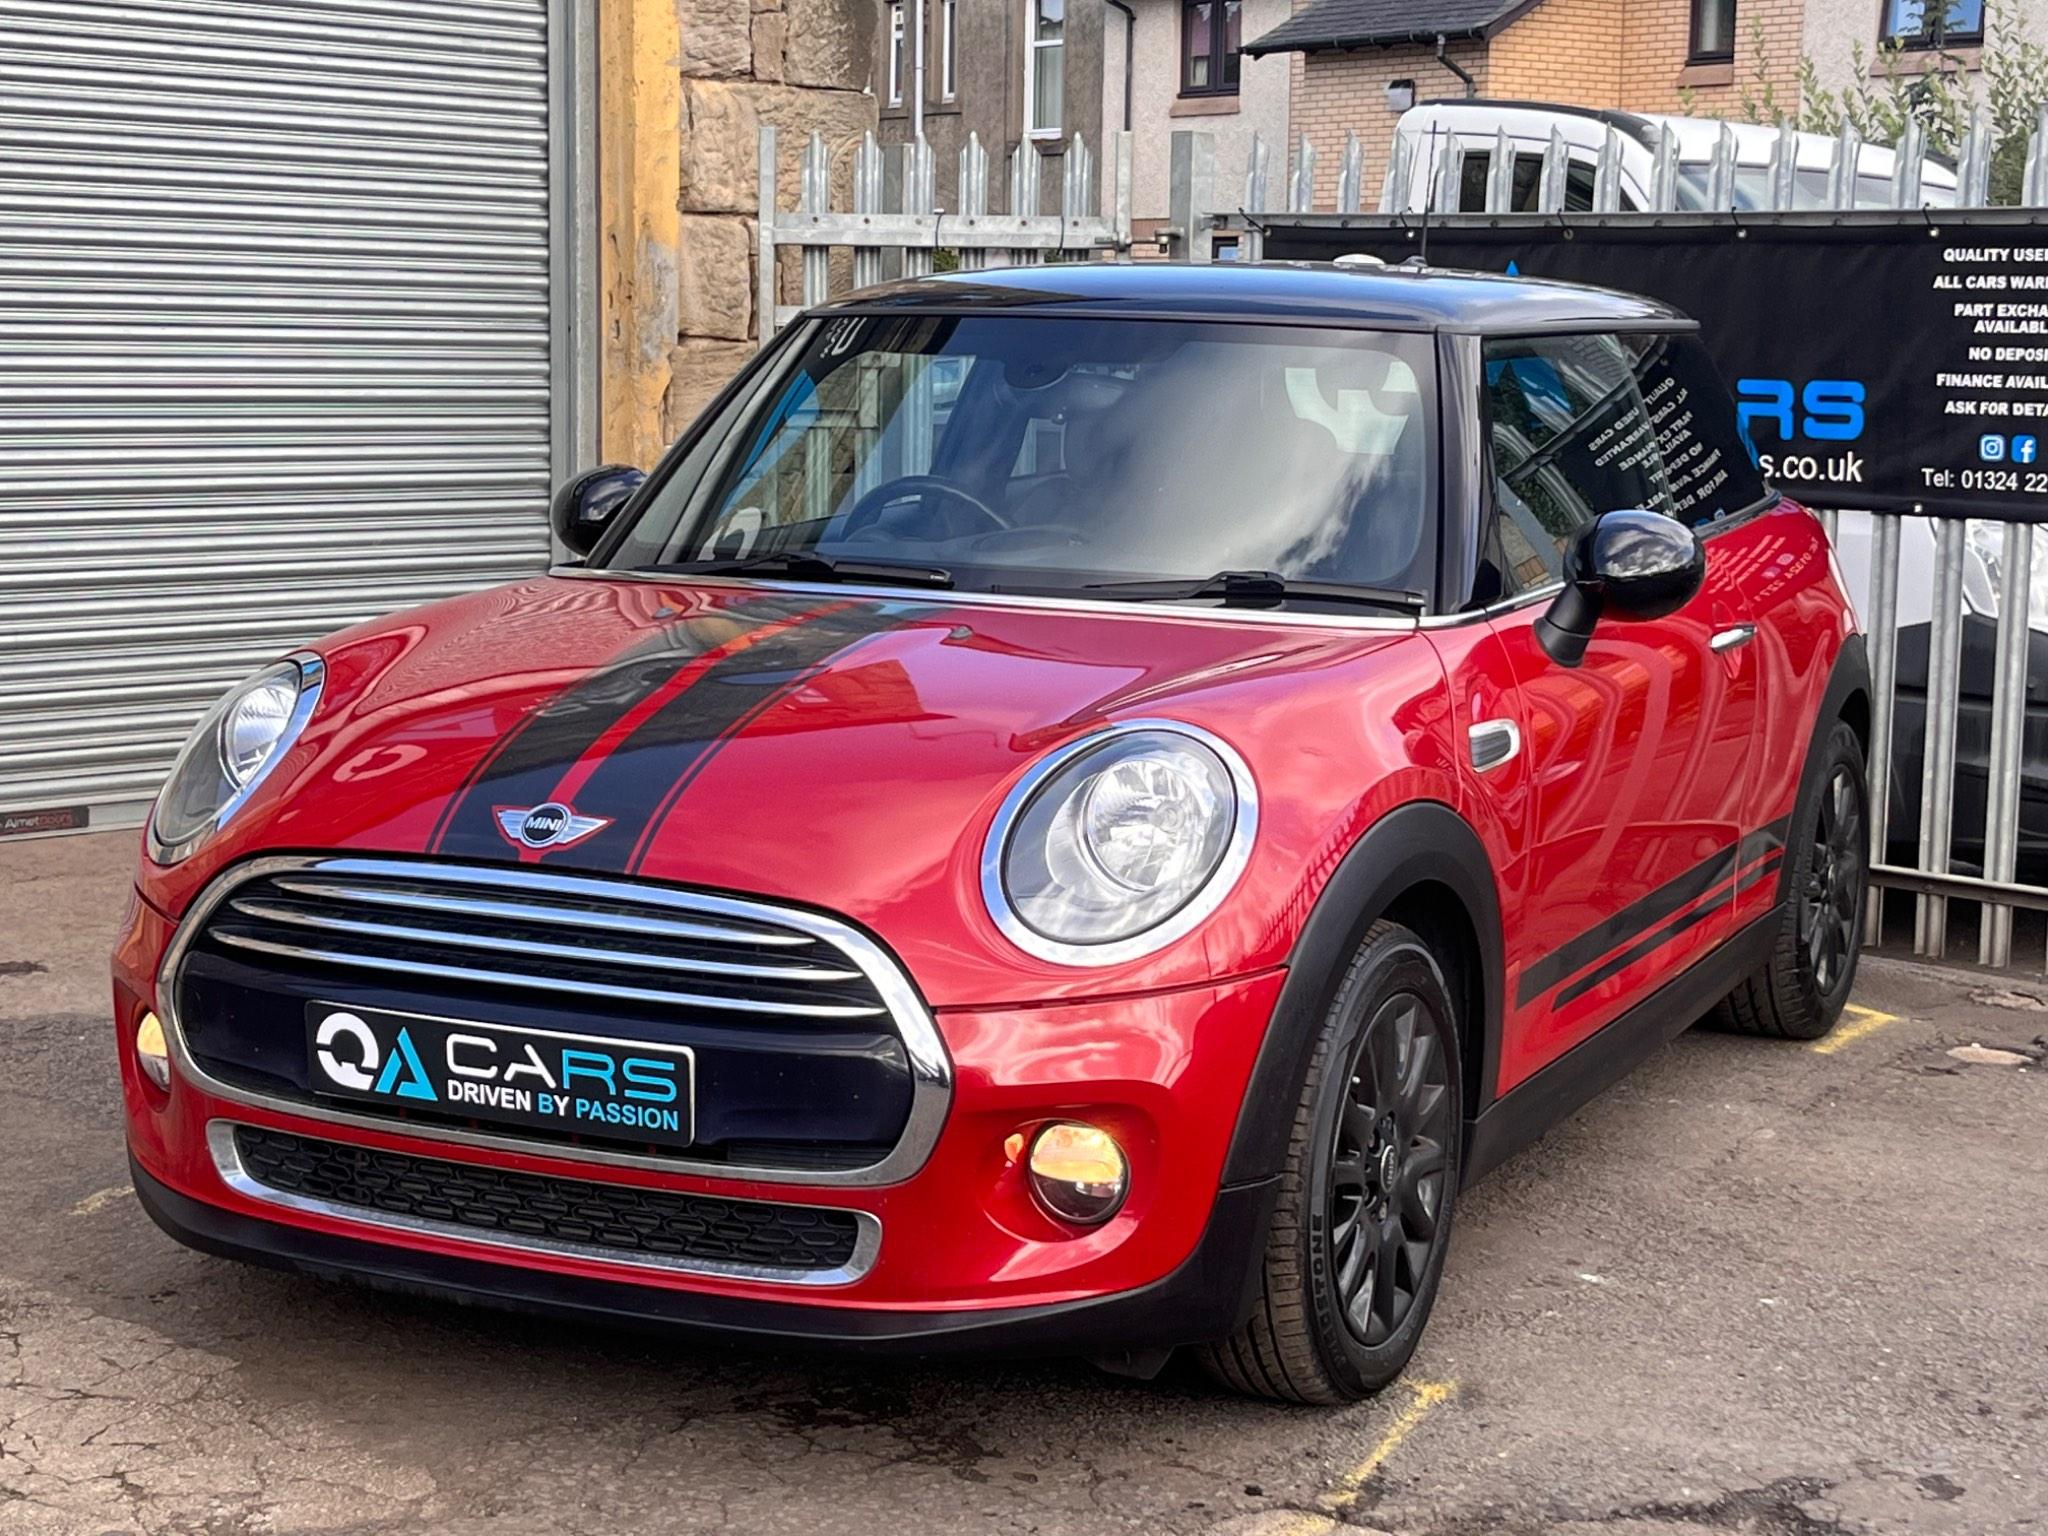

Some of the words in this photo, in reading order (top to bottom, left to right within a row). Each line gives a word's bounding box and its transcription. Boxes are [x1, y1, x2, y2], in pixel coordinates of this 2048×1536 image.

[1943, 247, 2010, 262] QUALITY
[1932, 275, 1962, 289] ALL
[1965, 275, 2007, 289] CARS
[1954, 303, 1994, 317] PART
[1973, 320, 2048, 334] AVAILABL
[1968, 347, 1992, 361] NO
[1936, 373, 2003, 388] FINANCE
[2004, 375, 2048, 389] AVAIL
[1944, 400, 1978, 415] ASK
[1979, 401, 2009, 416] FOR
[1759, 451, 1864, 482] s.co.uk
[1921, 467, 1955, 488] Tel:
[1961, 469, 2018, 491] 01324
[2024, 472, 2048, 493] 22
[525, 816, 563, 832] MINI
[446, 1033, 677, 1103] CARS
[447, 1079, 531, 1112] DRIVEN
[538, 1099, 569, 1117] BY
[575, 1101, 679, 1132] PASSION
